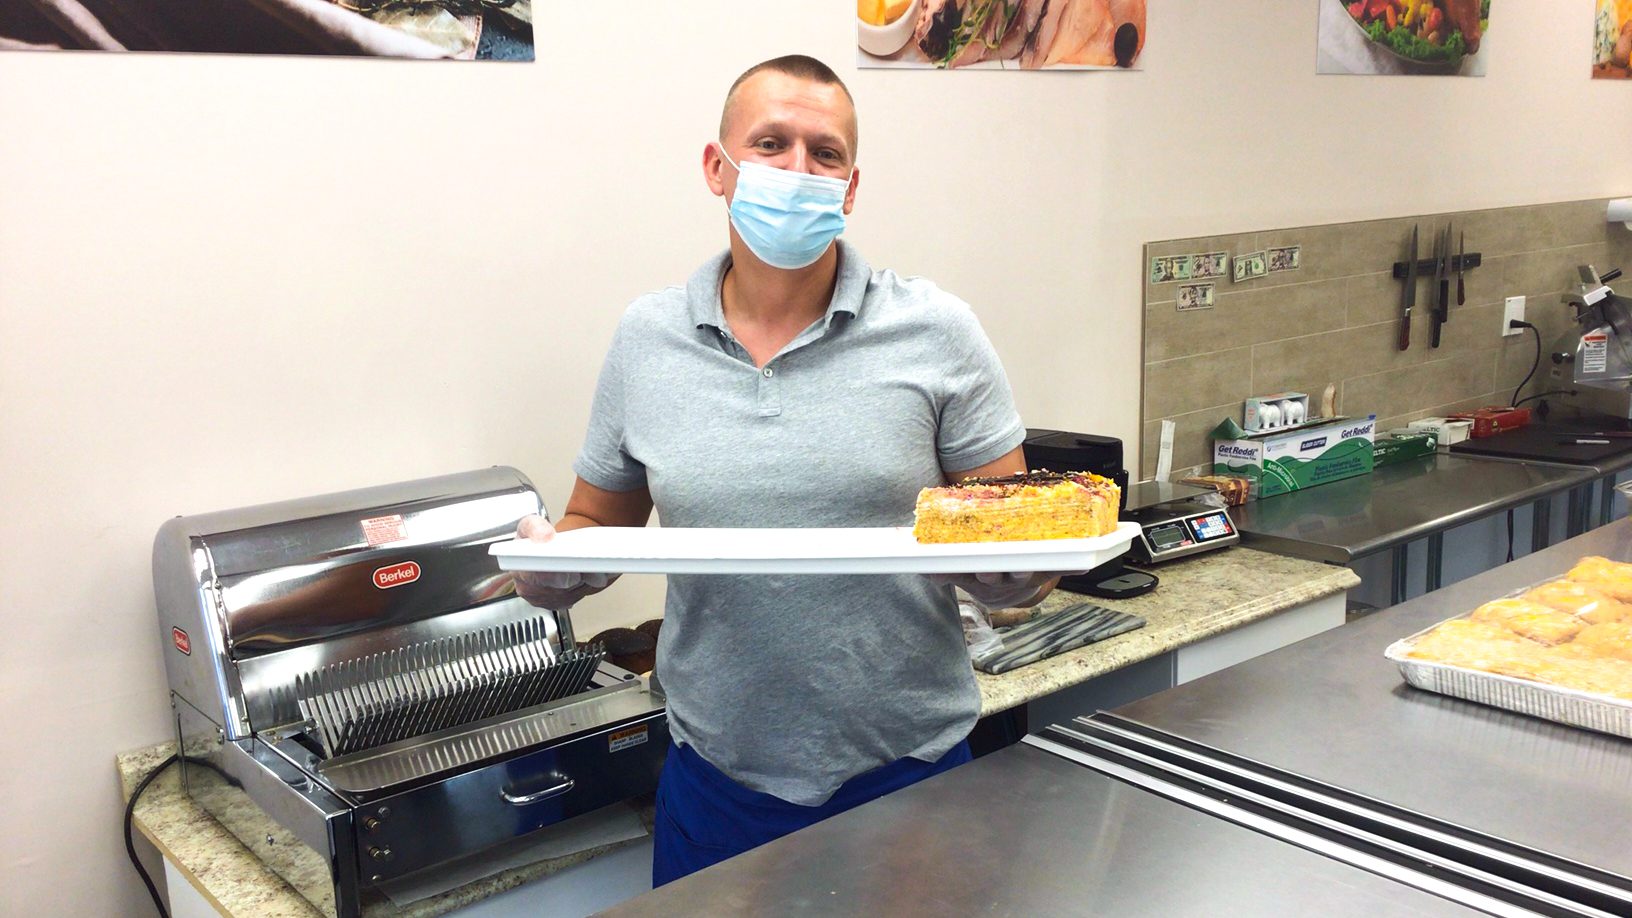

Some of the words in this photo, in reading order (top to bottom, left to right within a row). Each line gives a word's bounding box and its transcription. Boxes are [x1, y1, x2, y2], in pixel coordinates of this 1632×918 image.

[1341, 428, 1353, 438] Get
[1353, 424, 1371, 437] Reddi
[1218, 445, 1232, 453] Get
[1232, 446, 1255, 456] Reddi
[379, 566, 414, 583] Berkel
